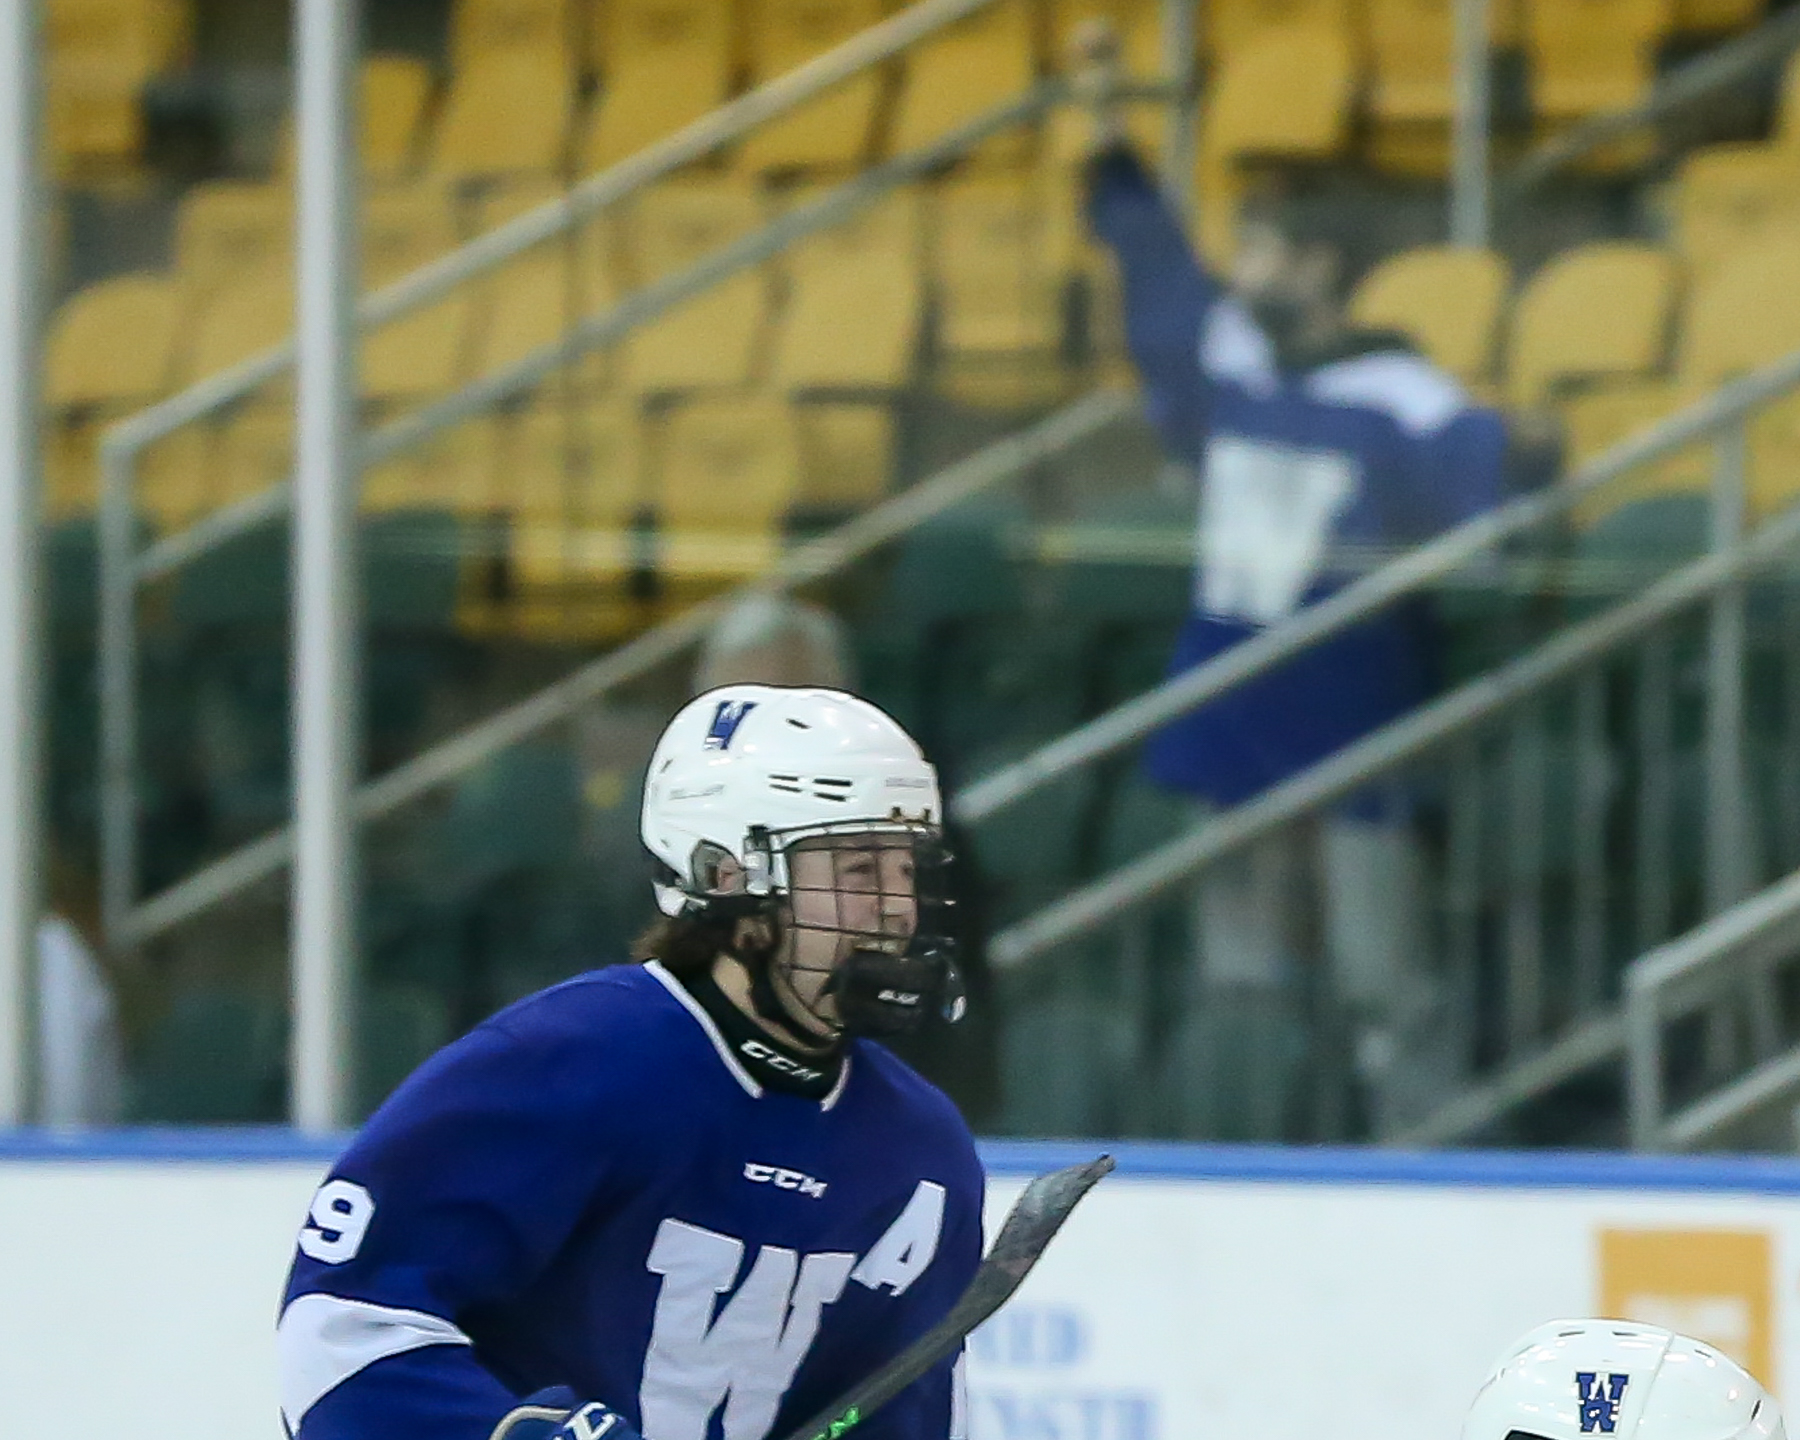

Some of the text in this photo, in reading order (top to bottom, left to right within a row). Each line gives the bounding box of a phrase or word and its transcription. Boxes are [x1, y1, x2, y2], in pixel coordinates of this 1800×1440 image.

[740, 1040, 823, 1082] CCM
[744, 1162, 828, 1198] CCM
[850, 1180, 947, 1297] A
